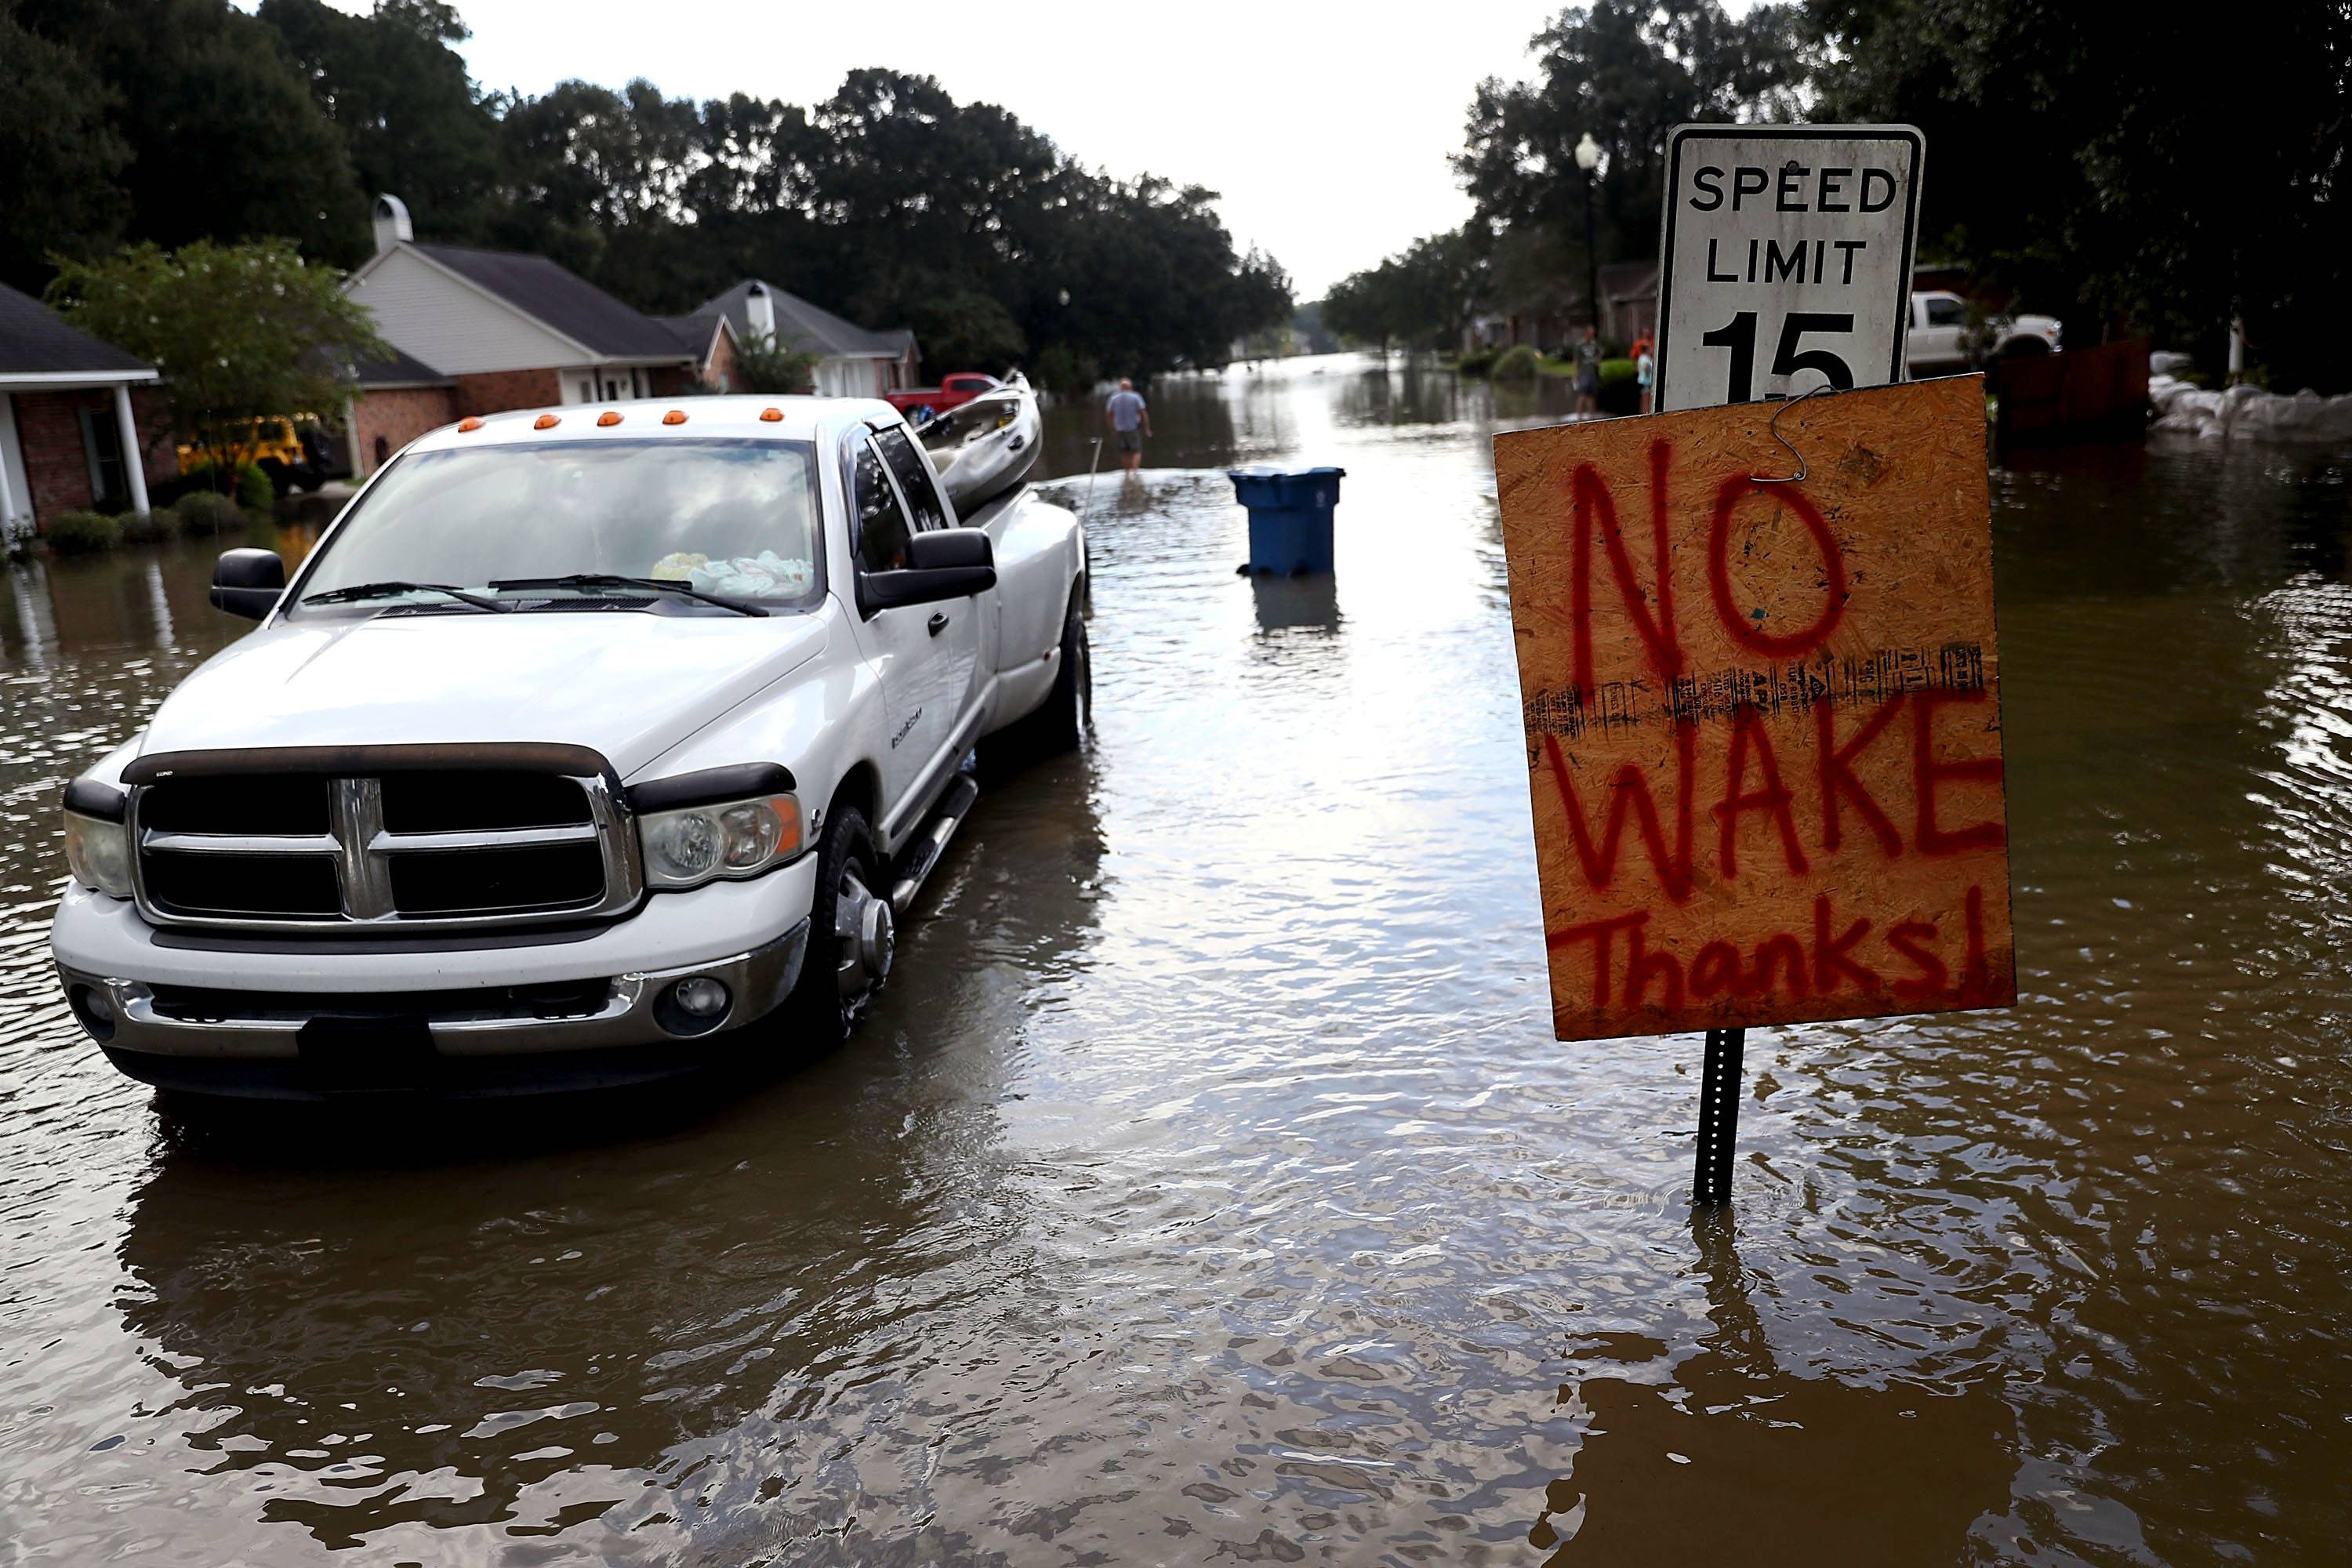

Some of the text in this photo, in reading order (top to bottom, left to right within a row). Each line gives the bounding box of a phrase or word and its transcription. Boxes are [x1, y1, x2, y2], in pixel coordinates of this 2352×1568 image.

[1688, 165, 1897, 213] SPEED
[1706, 238, 1867, 285] LIMIT
[1702, 311, 1855, 404] 15
[1568, 437, 1847, 706] NO
[1544, 688, 2005, 903] WAKE
[1547, 885, 1991, 1011] Thanks!
